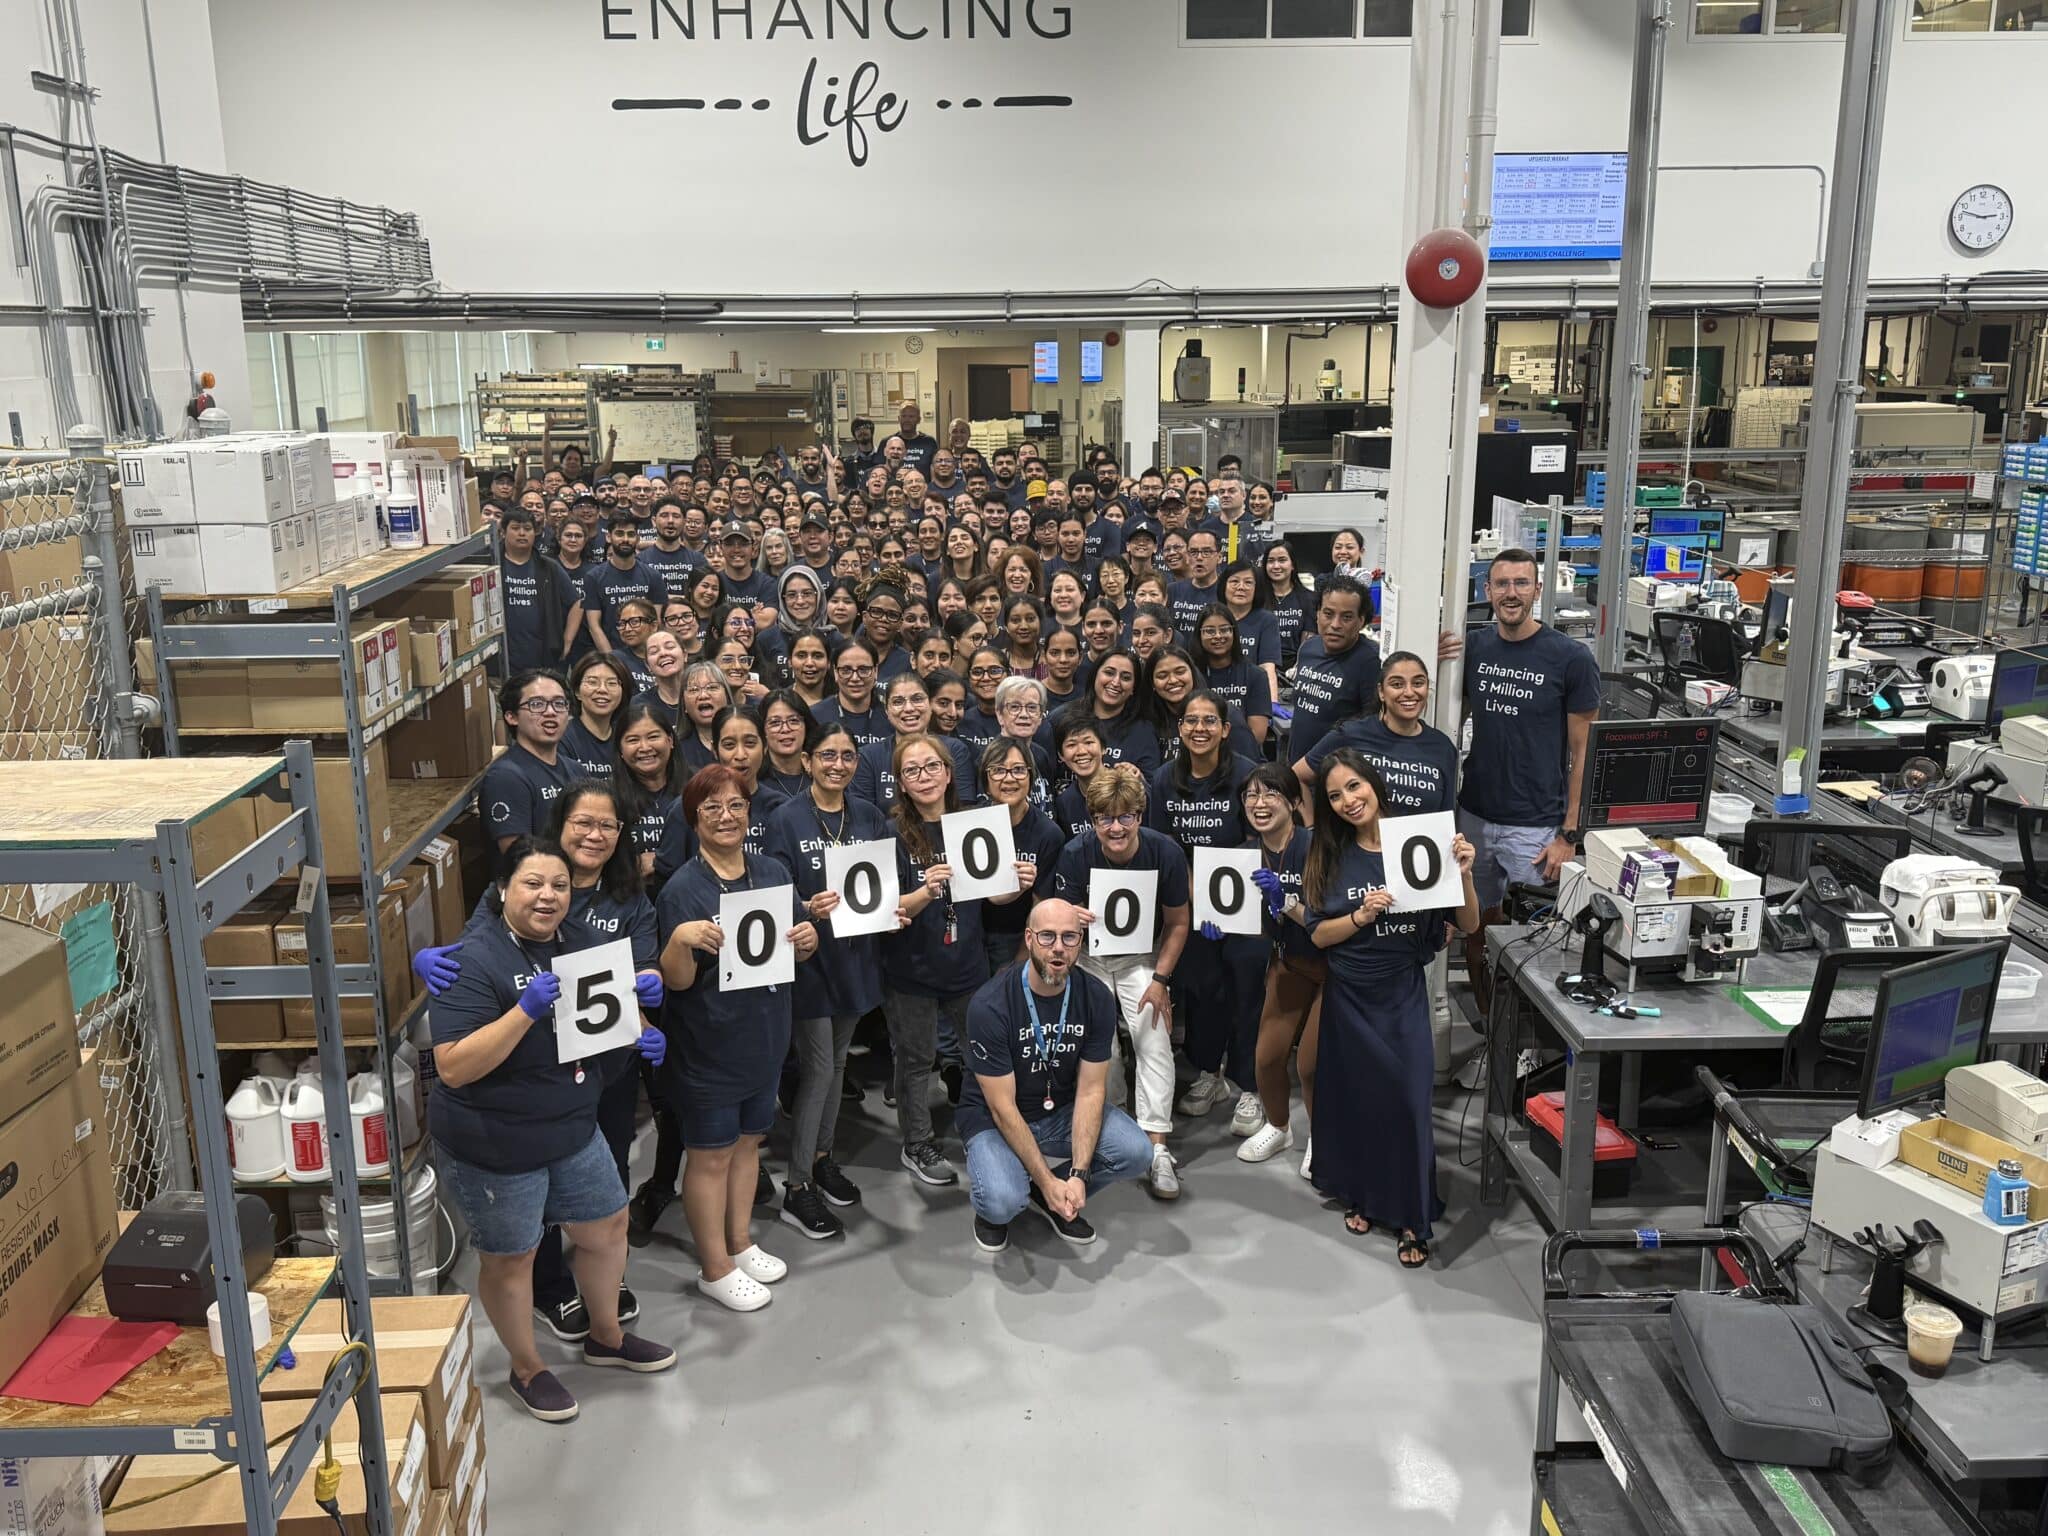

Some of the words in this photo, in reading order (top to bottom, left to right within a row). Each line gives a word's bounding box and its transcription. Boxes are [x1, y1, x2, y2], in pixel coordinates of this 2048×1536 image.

[603, 0, 1072, 40] ENHANCING
[797, 57, 908, 167] Life
[505, 575, 536, 585] hancin
[605, 583, 649, 595] Enhancing
[509, 587, 538, 595] Million
[508, 598, 532, 606] Lives
[1173, 601, 1207, 611] Enhanc
[1182, 612, 1198, 621] Mill
[1279, 618, 1299, 627] llion
[1299, 665, 1344, 689] Enhancing
[1477, 662, 1545, 686] Enhancing
[1301, 682, 1332, 701] Million
[1478, 680, 1488, 692] 5
[1490, 682, 1533, 700] Million
[1297, 697, 1320, 714] Lives
[1485, 699, 1519, 716] Lives
[1386, 772, 1436, 792] Million
[1166, 799, 1230, 814] Enhancing
[1388, 789, 1422, 807] ives
[1182, 815, 1223, 829] Million
[1180, 833, 1212, 845] Lives
[811, 856, 821, 870] 5
[961, 827, 1000, 881] 0
[1401, 834, 1442, 891] 0
[843, 861, 882, 915] 0
[1208, 866, 1245, 916] 0
[1375, 922, 1416, 937] Lives
[575, 969, 622, 1036] 5
[1021, 1046, 1031, 1059] 5
[1940, 1152, 1968, 1173] ULINE
[1, 1211, 42, 1262] RESISTANT
[33, 1215, 61, 1259] MASK
